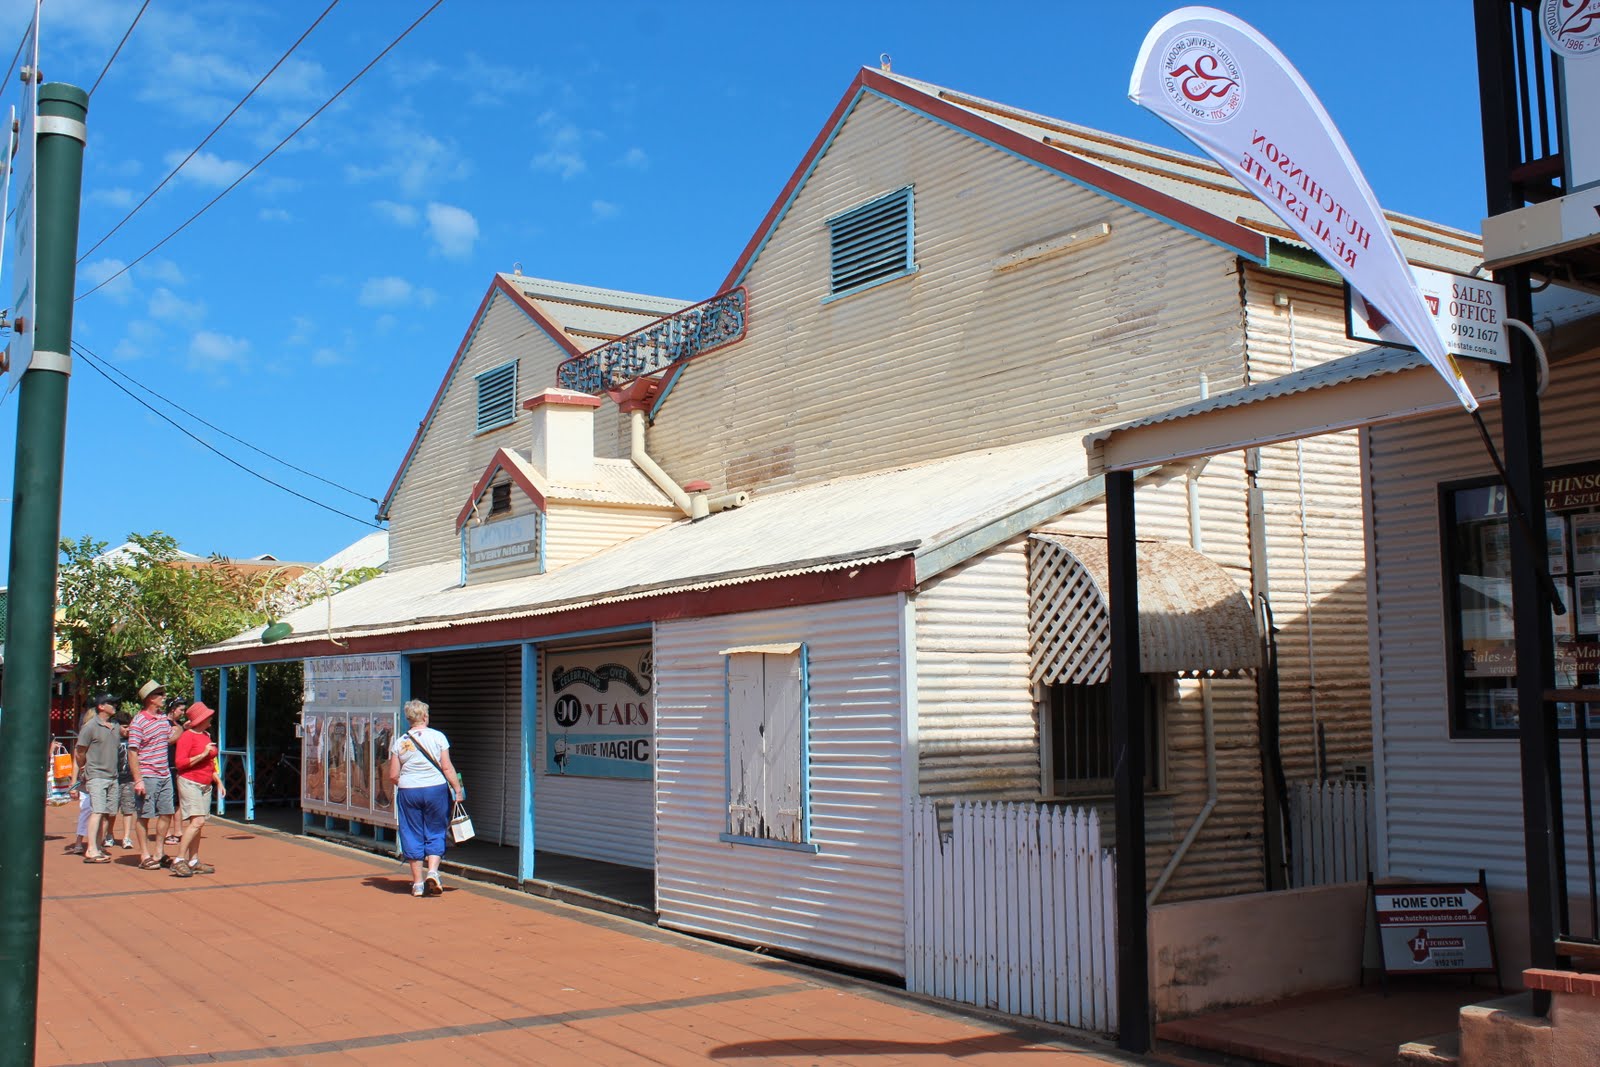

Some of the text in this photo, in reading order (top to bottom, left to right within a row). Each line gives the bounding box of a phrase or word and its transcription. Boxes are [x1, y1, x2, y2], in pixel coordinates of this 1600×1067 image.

[1564, 38, 1585, 51] 1986
[1452, 283, 1492, 306] SALES
[1449, 301, 1497, 325] OFFICE
[1451, 323, 1498, 342] 9192 1677
[1446, 341, 1497, 355] alestate.com.au
[475, 543, 530, 561] EVERY NIGHT
[560, 667, 628, 688] CELEBRATING OVER
[556, 699, 649, 726] 90 YEARS
[581, 743, 597, 756] MOVIE
[600, 739, 649, 762] MAGIC
[1392, 896, 1463, 908] HOME OPEN
